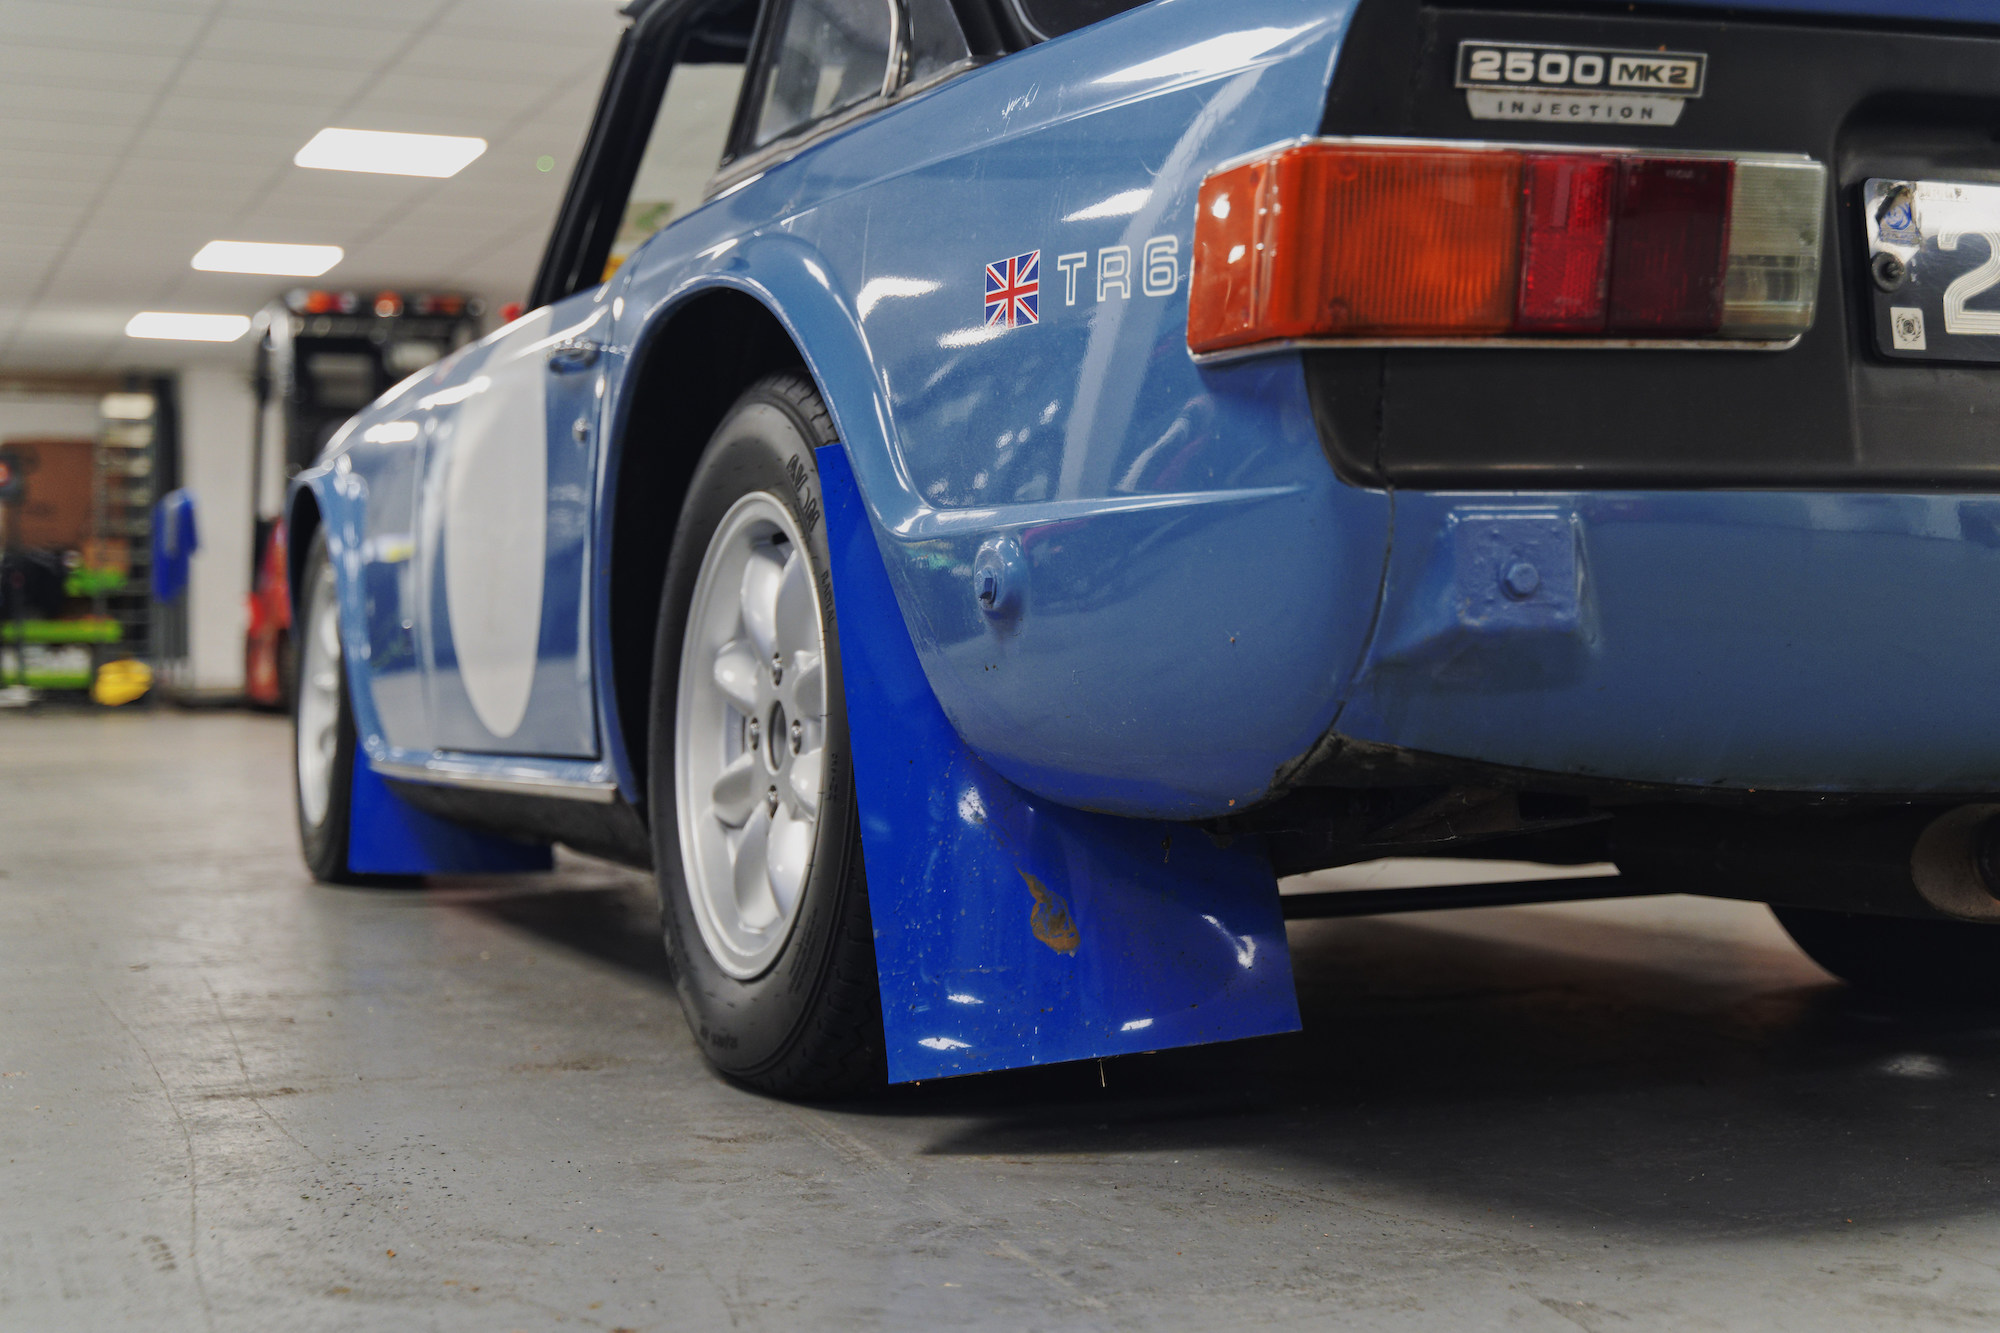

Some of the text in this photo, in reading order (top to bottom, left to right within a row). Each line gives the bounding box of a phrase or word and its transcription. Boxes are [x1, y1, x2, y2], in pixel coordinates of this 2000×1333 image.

[1469, 50, 1688, 85] 2500 MK2
[1497, 100, 1654, 119] INJECTION
[1056, 233, 1179, 306] TR6
